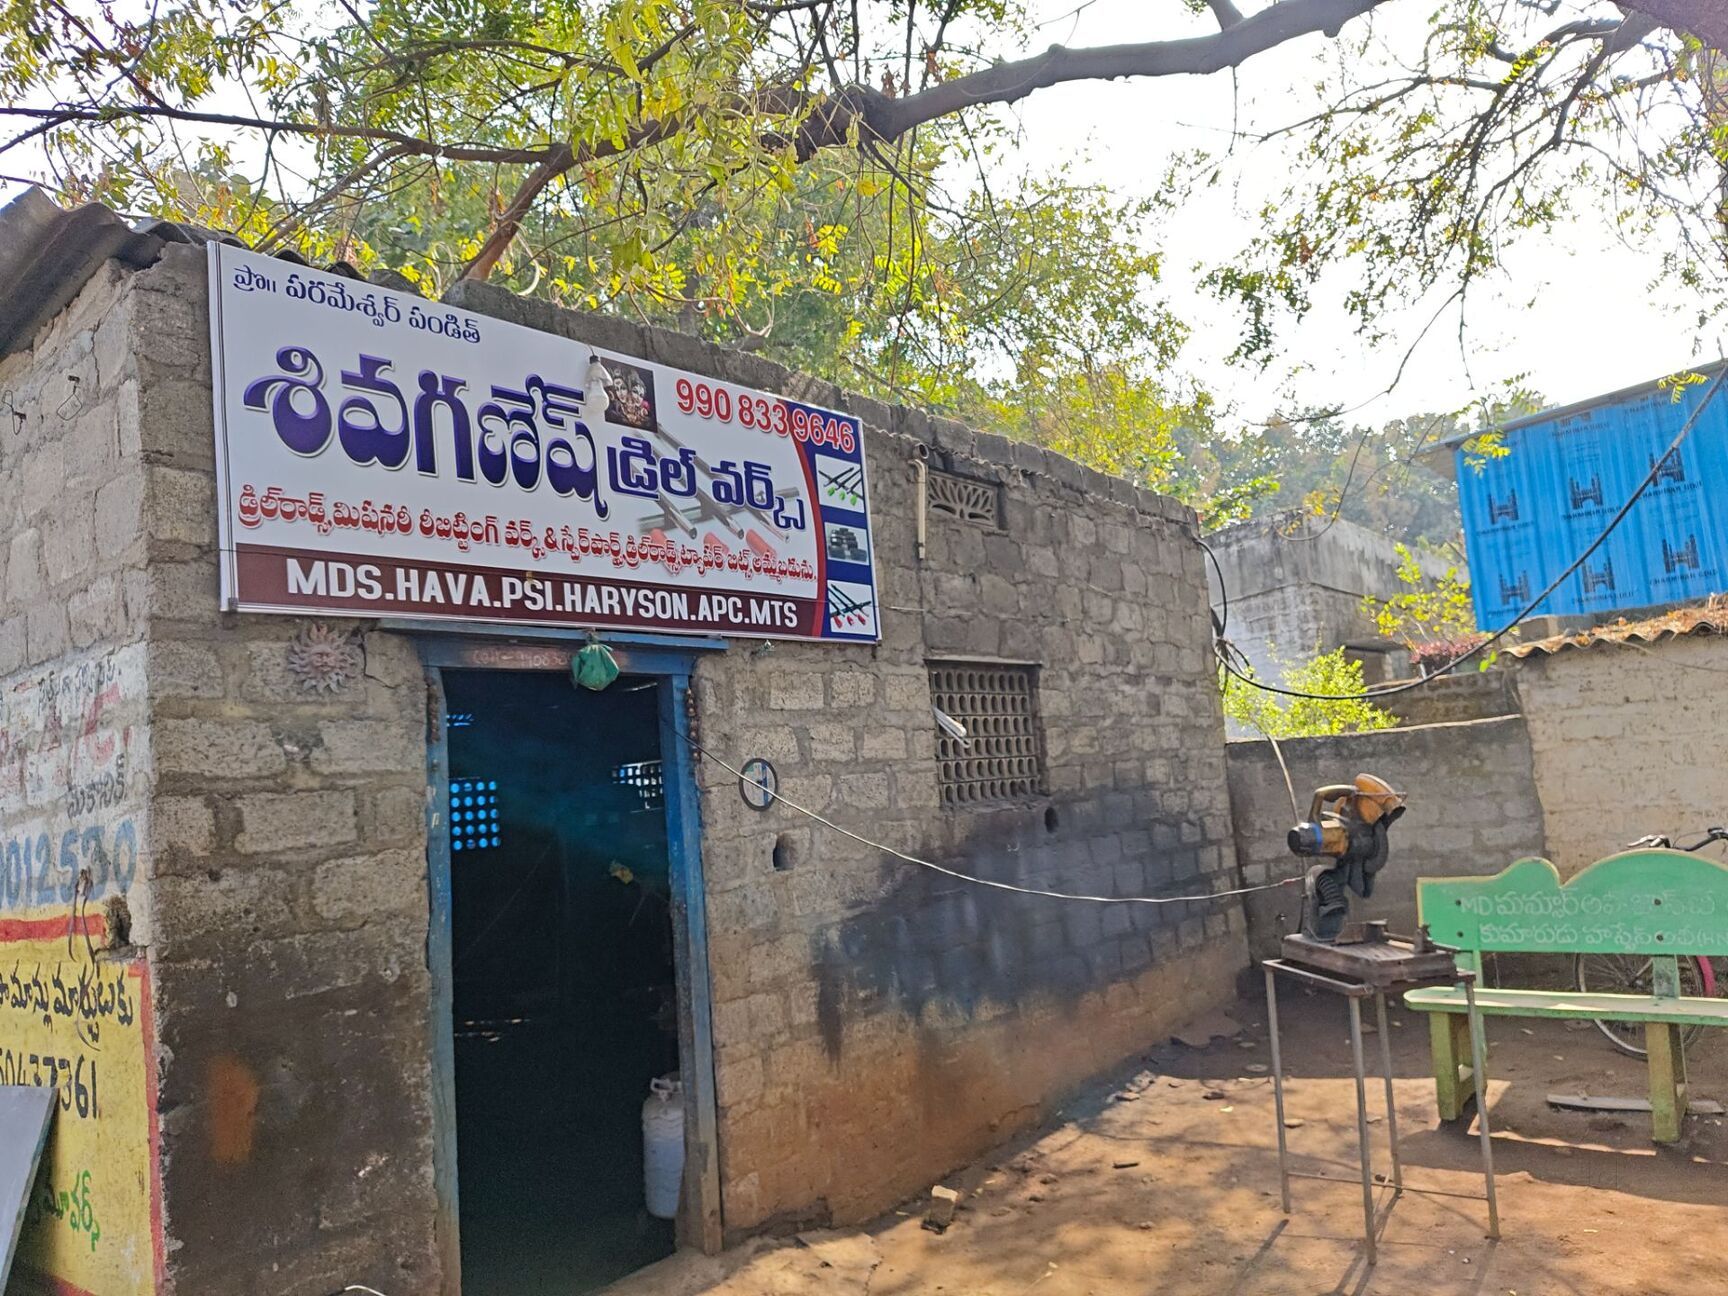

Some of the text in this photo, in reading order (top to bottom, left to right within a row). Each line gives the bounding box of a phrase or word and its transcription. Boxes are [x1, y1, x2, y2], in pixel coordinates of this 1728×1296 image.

[285, 273, 401, 328] పరమేశ్వర్
[408, 306, 481, 344] పండిత్
[243, 345, 609, 520] శివగణేష్
[607, 436, 698, 499] డ్రిల్
[676, 378, 856, 454] 990 833 9646
